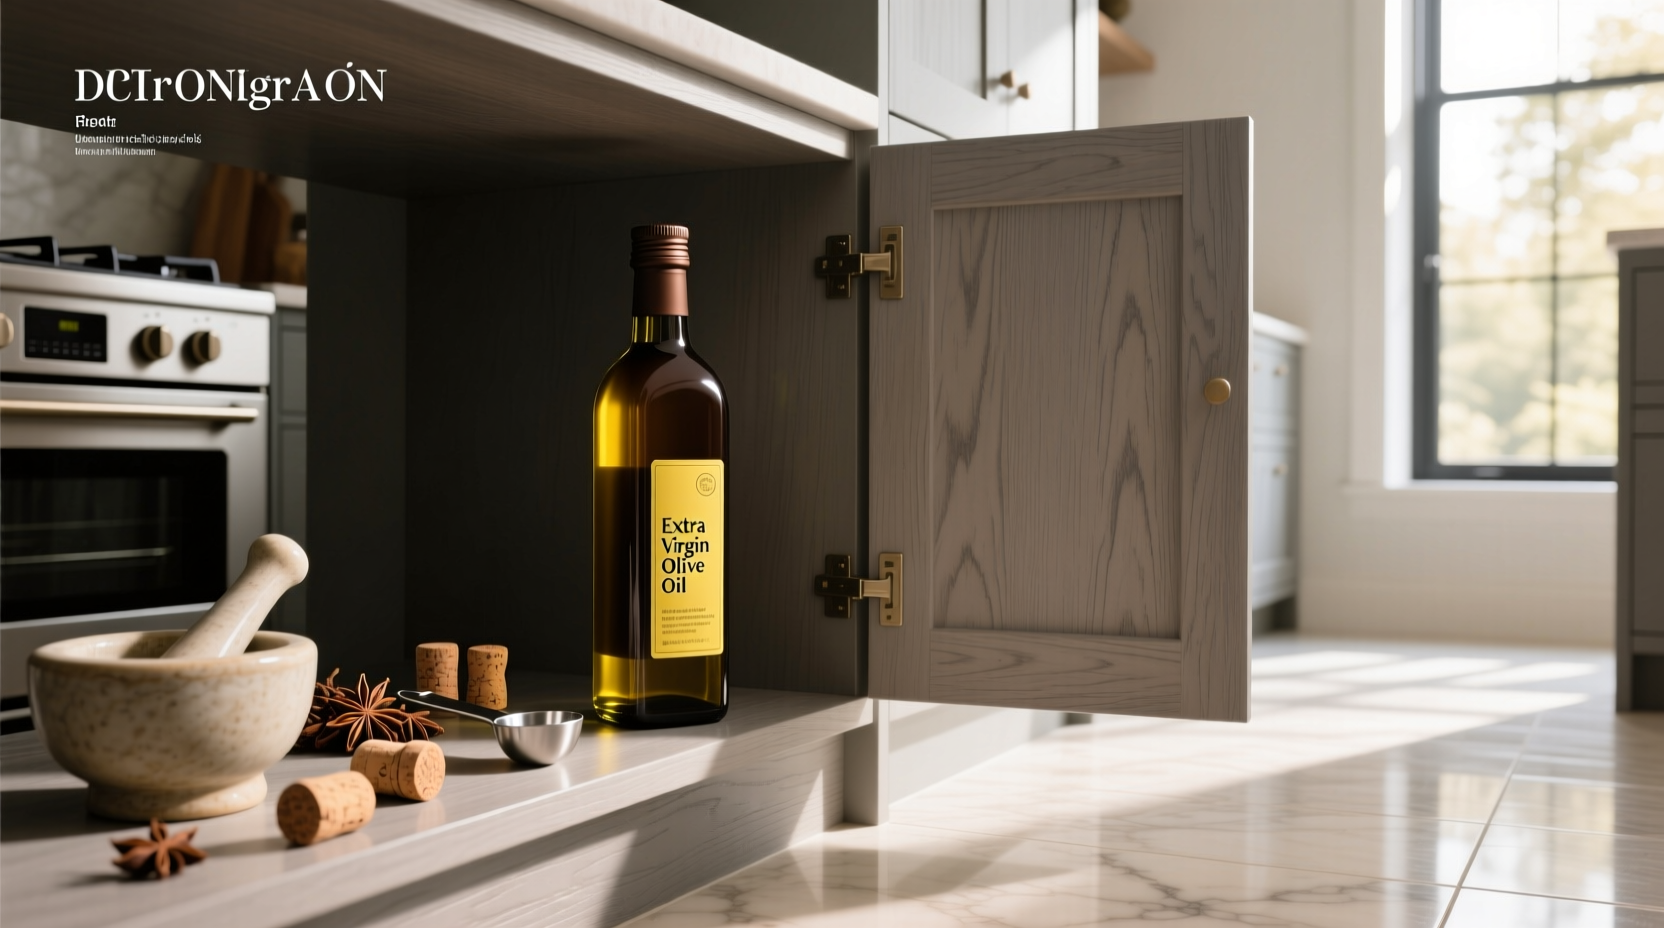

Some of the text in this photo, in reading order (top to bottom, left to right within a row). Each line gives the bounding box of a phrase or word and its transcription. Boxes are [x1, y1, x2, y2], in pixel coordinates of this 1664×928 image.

[662, 517, 706, 534] Extra
[661, 536, 709, 558] Virgin
[661, 557, 705, 574] Olive
[661, 576, 686, 594] Oil
